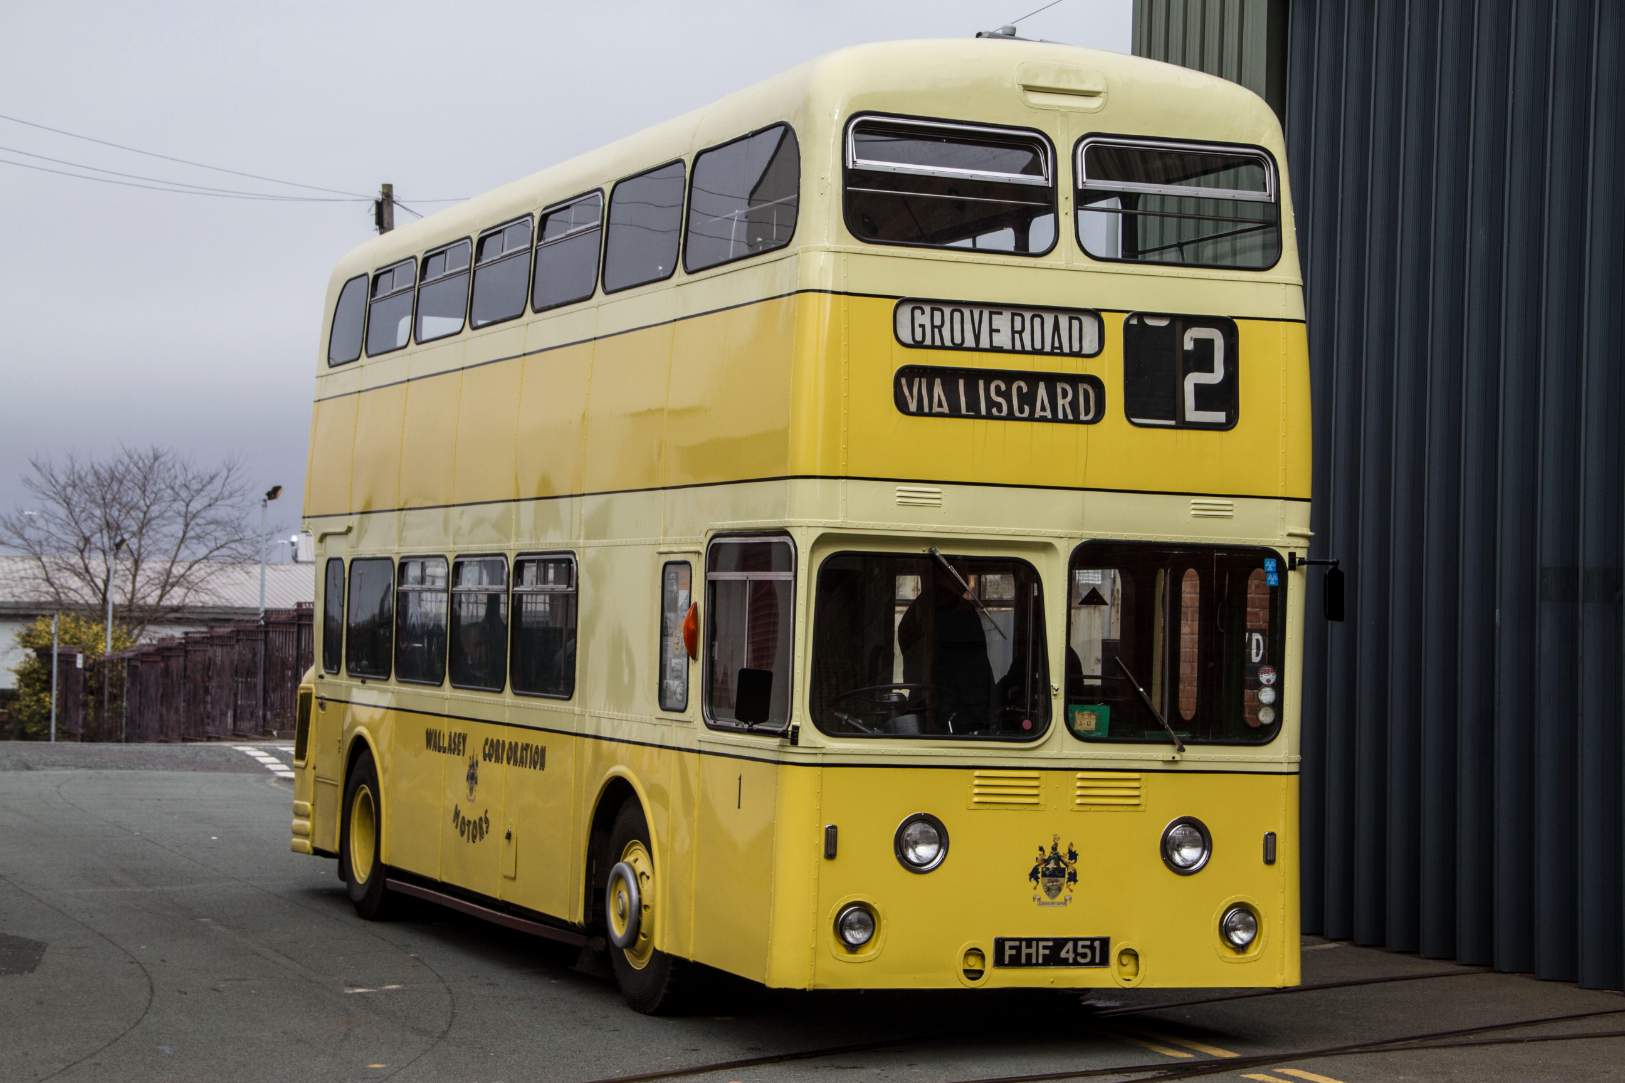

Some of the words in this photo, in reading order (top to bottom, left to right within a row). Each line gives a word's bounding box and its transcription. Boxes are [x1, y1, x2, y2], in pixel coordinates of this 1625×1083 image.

[909, 304, 1004, 350] GROVE
[1011, 310, 1084, 355] ROAD
[1183, 326, 1227, 424] 2
[900, 375, 950, 414] VIA
[960, 378, 1096, 421] LISCARD
[425, 727, 468, 757] WALLASEY
[482, 736, 547, 772] CORPORATION
[452, 803, 490, 844] MOTORS
[1003, 940, 1054, 965] FHF
[1059, 939, 1101, 964] 451
